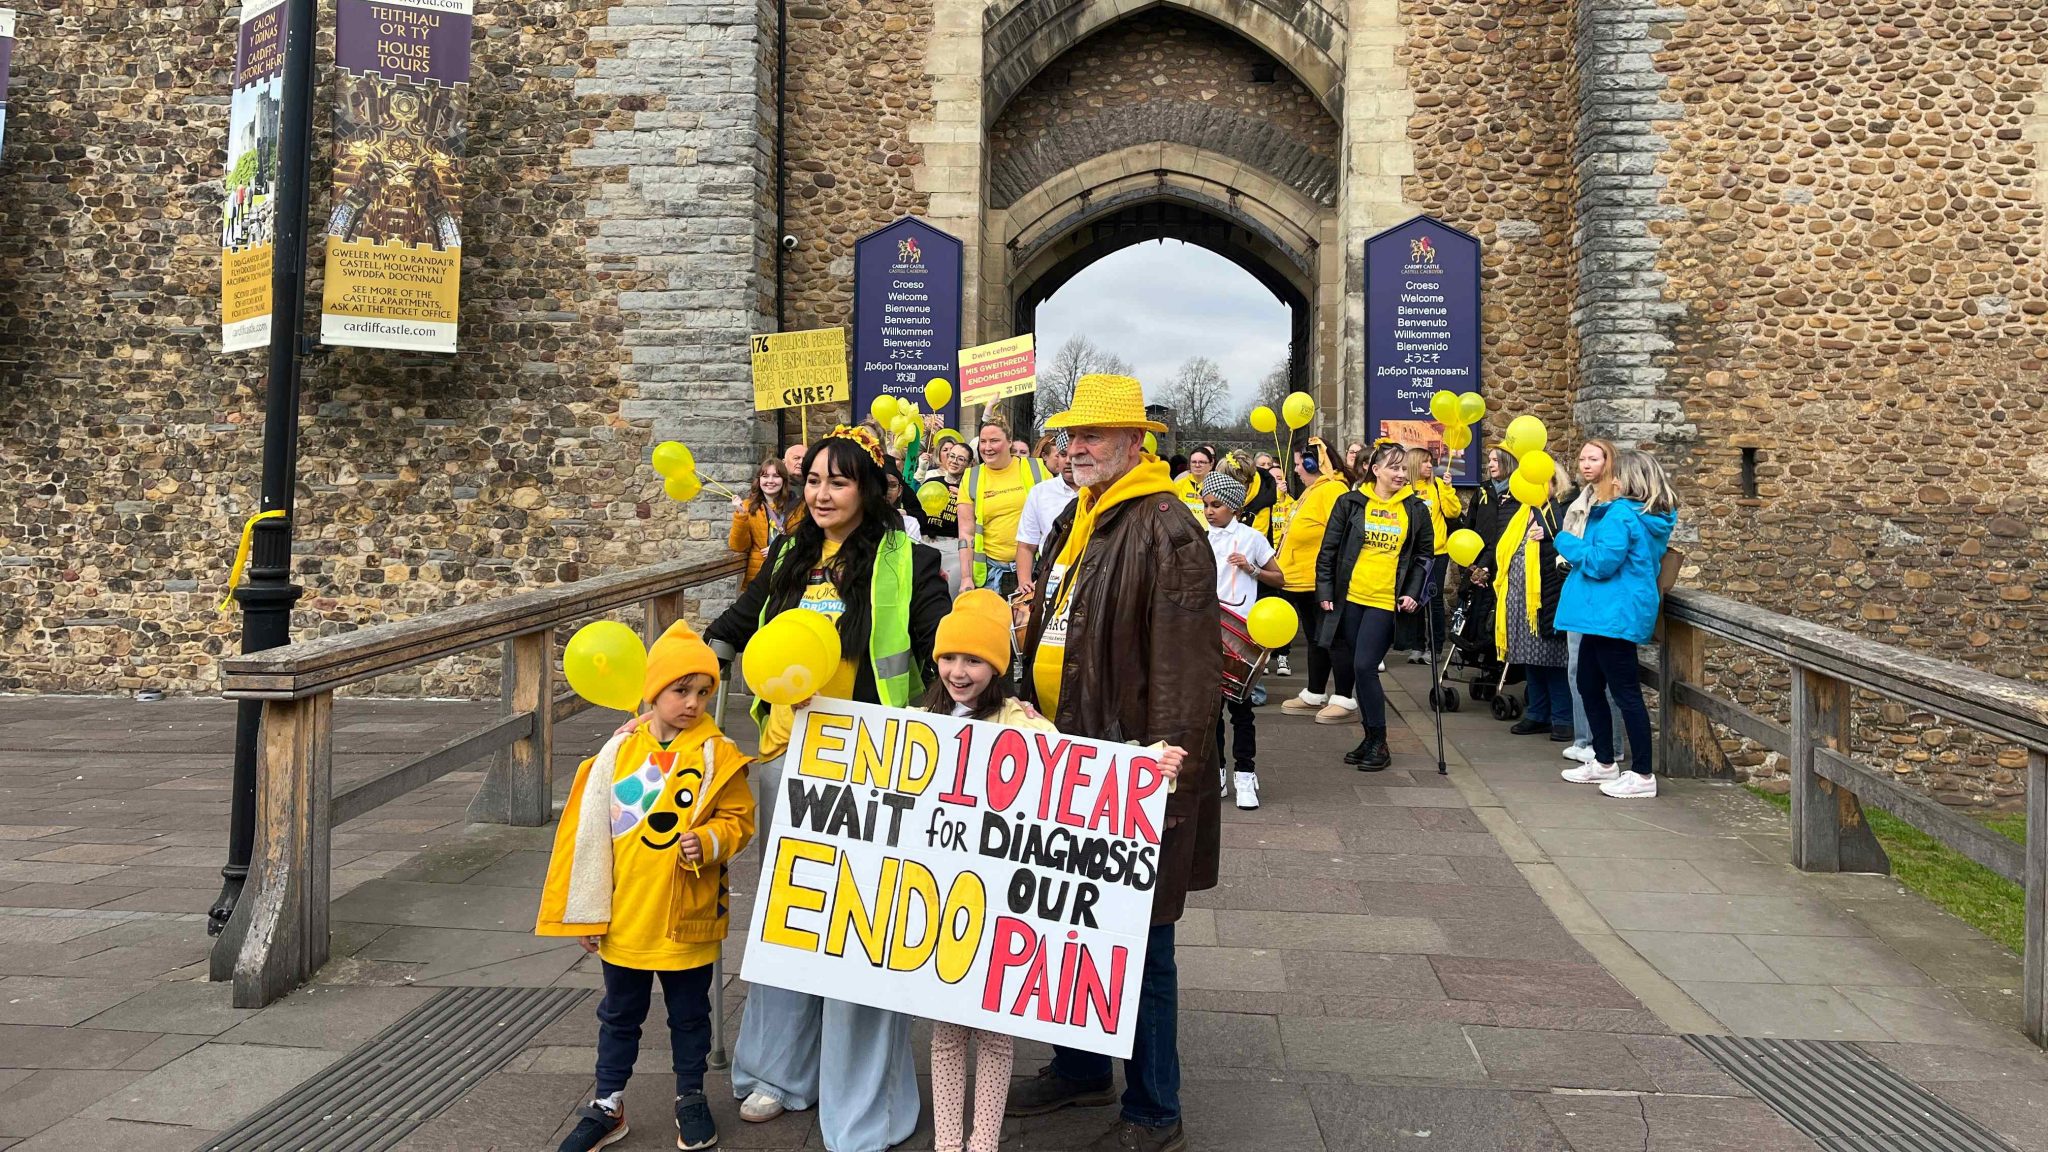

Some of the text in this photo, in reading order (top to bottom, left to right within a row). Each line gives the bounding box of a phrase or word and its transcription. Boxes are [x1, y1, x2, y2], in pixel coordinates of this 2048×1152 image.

[253, 11, 276, 32] CALON
[371, 6, 440, 27] TEITHIAU
[380, 23, 406, 37] O'R
[377, 40, 430, 59] HOUSE
[378, 54, 430, 73] TOURS
[332, 248, 370, 260] GWELER
[373, 252, 397, 261] MWY
[400, 254, 408, 263] O
[339, 259, 447, 276] CASTELL, HOLWCH YN Y
[342, 268, 443, 284] SWYDDFA DOCYNNAU
[893, 280, 925, 289] Croeso
[1405, 281, 1440, 290] Croeso
[352, 285, 433, 299] SEE MORE OF THE
[888, 292, 929, 301] Welcome
[1400, 293, 1444, 303] Welcome
[342, 294, 442, 309] CASTLE APARTMENTS,
[330, 302, 451, 319] ASK AT THE TICKET OFFICE
[885, 304, 931, 313] Bienvenue
[1397, 305, 1447, 315] Bienvenue
[884, 315, 931, 324] Benvenuto
[1397, 317, 1448, 327] Benvenuto
[343, 322, 436, 337] cardiffcastle.com
[881, 327, 934, 336] Willkommen
[1394, 329, 1451, 339] Willkommen
[752, 336, 769, 354] 176
[771, 332, 809, 352] MILLION
[883, 338, 931, 348] Bienvenido
[1396, 341, 1449, 351] Bienvenido
[889, 349, 924, 360] ようこそ
[1404, 353, 1441, 363] ようこそ
[865, 361, 949, 372] Добро Пожаловать!
[965, 355, 1028, 376] MIS GWEITHREDU
[1377, 366, 1469, 377] Добро Пожаловать!
[796, 366, 842, 386] WORTH
[896, 372, 916, 383] 欢迎
[967, 366, 1028, 386] ENDOMETRIOSIS
[882, 384, 925, 393] Bem-vind
[1411, 377, 1433, 388] 欢迎
[782, 384, 834, 405] CURE?
[1397, 389, 1441, 399] Bem-vin
[798, 710, 940, 796] END
[1034, 733, 1164, 845] YEAR
[1006, 867, 1100, 929] OUR
[760, 836, 987, 985] ENDO
